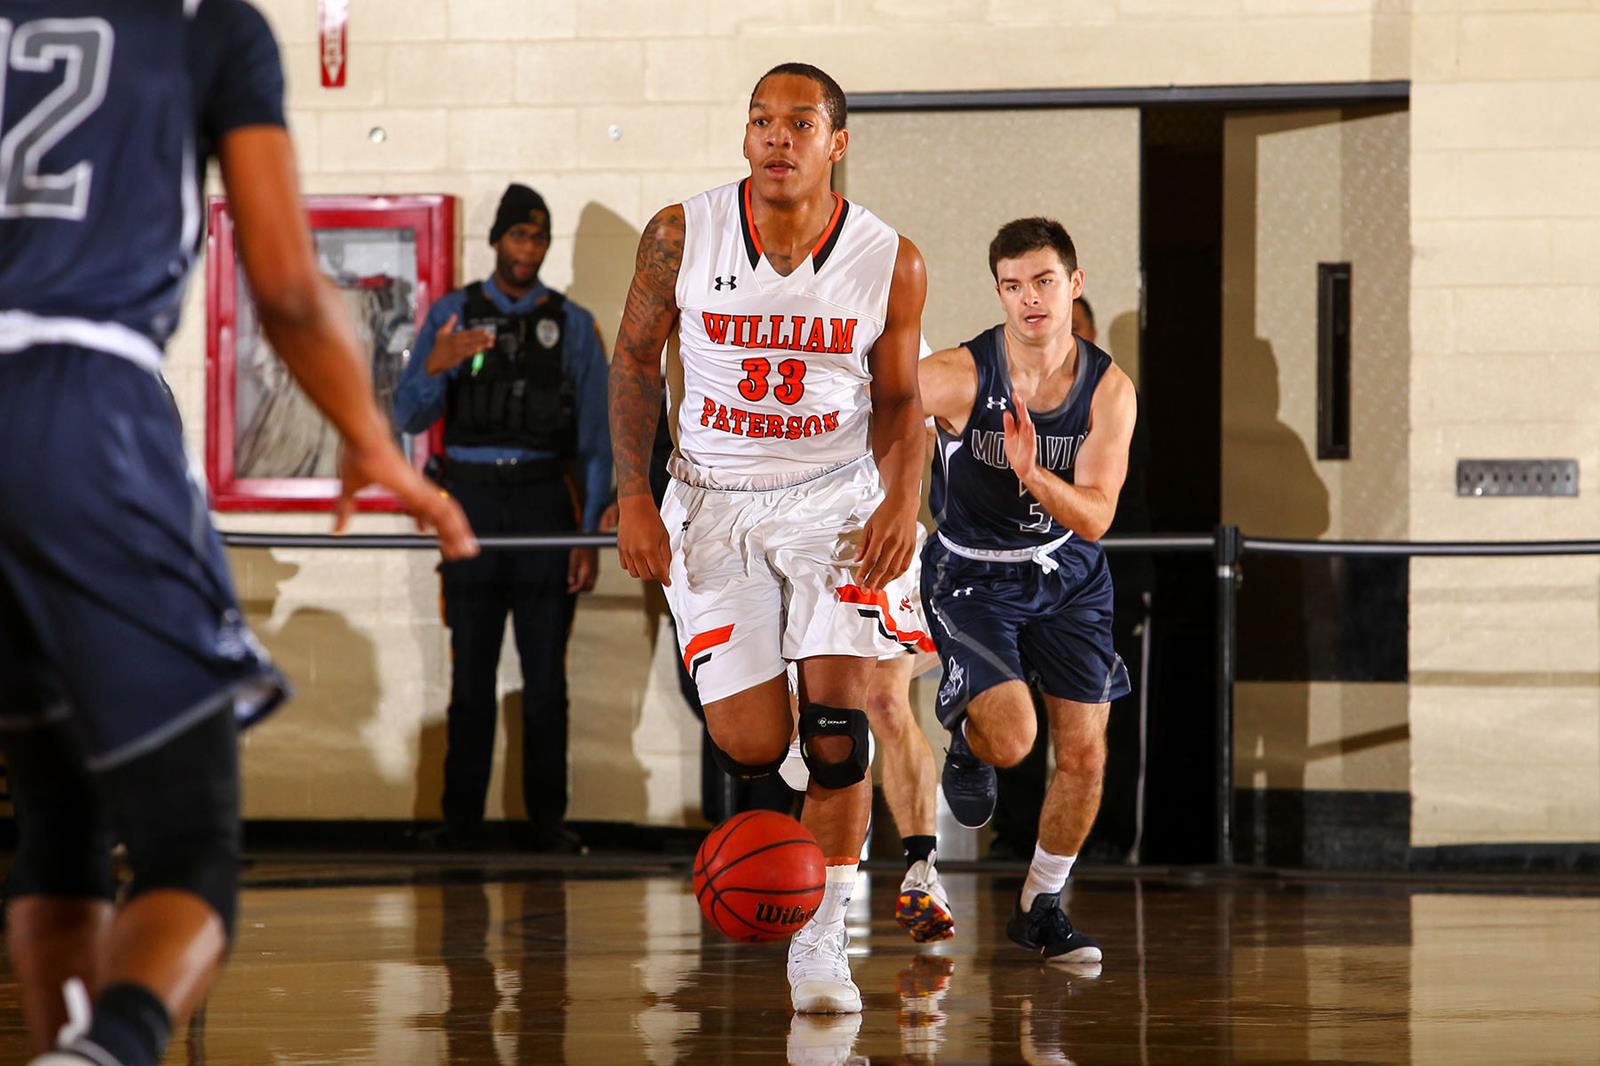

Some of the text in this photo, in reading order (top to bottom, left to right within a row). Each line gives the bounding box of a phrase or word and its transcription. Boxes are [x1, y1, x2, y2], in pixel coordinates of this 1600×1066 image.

[702, 311, 858, 354] WILLIAM
[738, 357, 807, 405] 33
[700, 396, 840, 440] PATERSON
